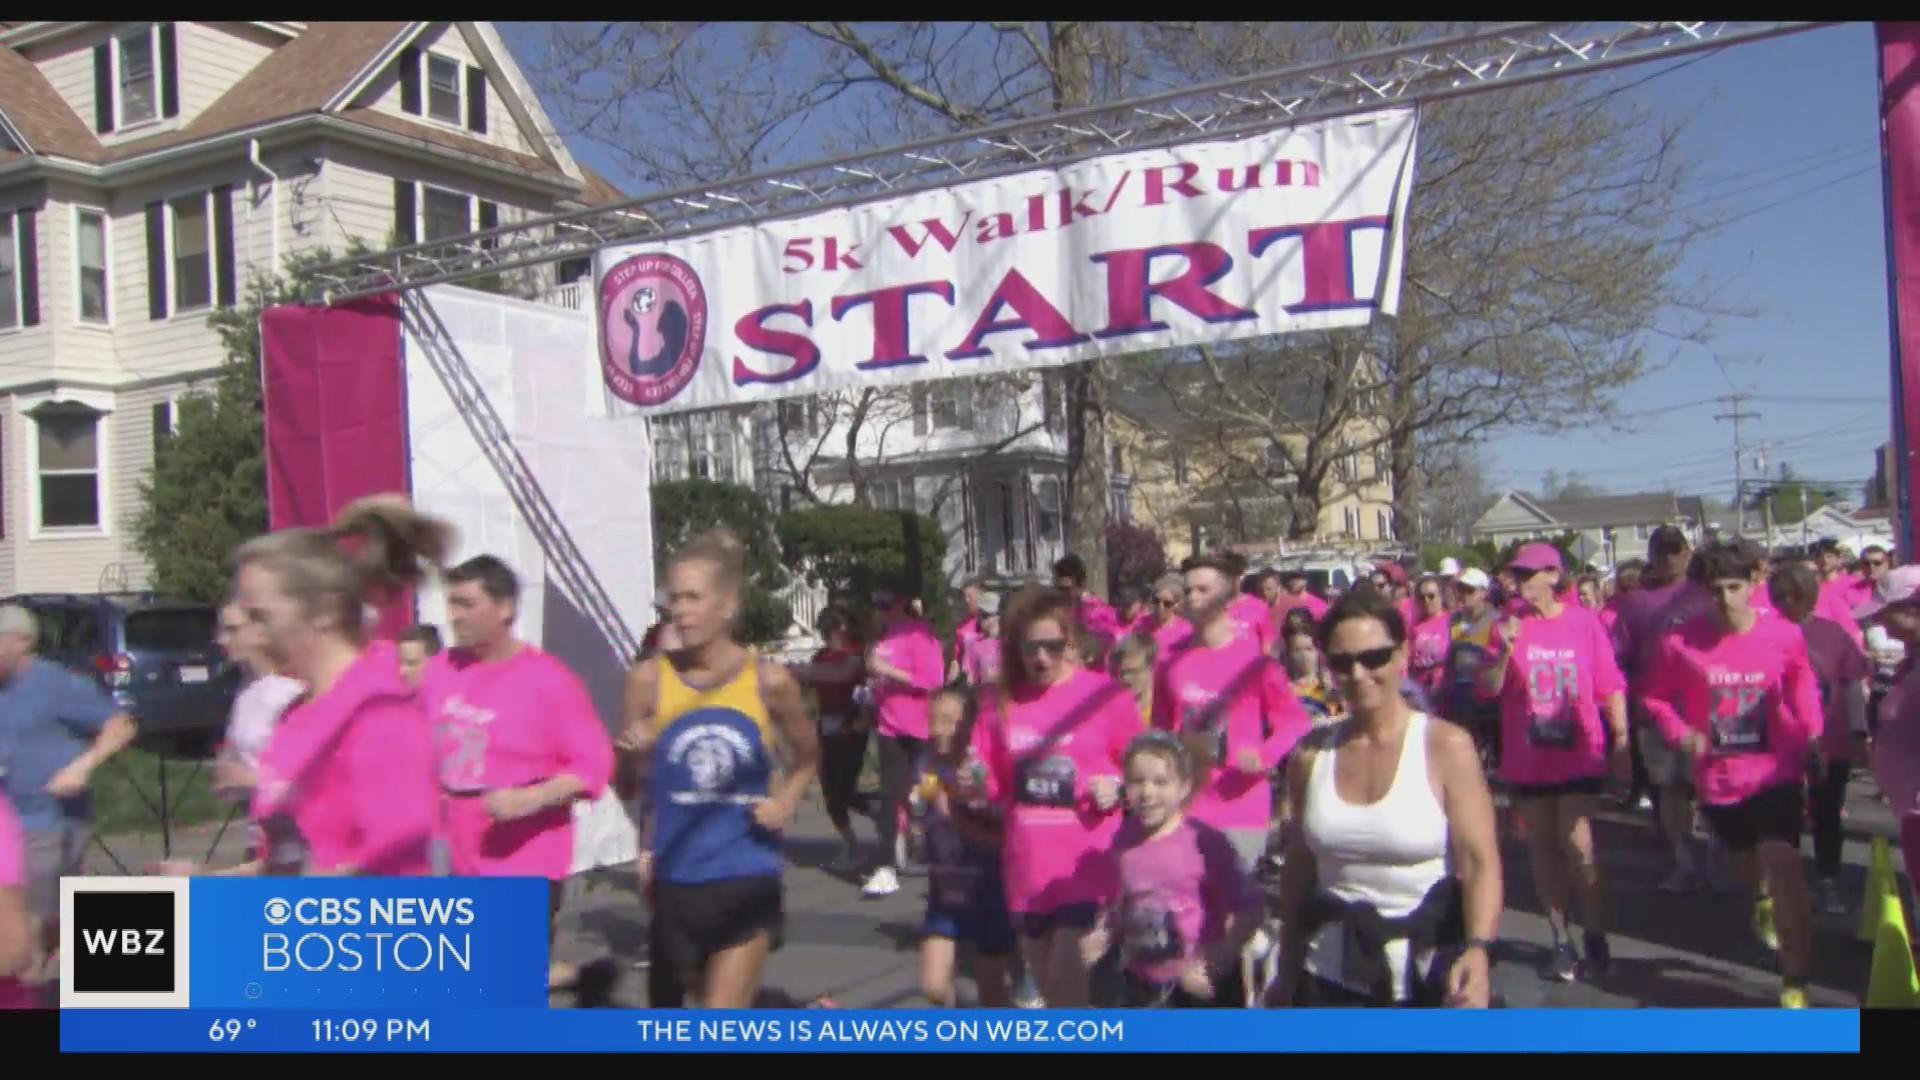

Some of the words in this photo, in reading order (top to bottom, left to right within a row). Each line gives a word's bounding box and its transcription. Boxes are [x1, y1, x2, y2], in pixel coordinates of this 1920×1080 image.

[638, 260, 654, 273] UP
[780, 236, 863, 274] 5k
[888, 160, 1321, 259] Walk/Run
[732, 214, 1393, 386] START
